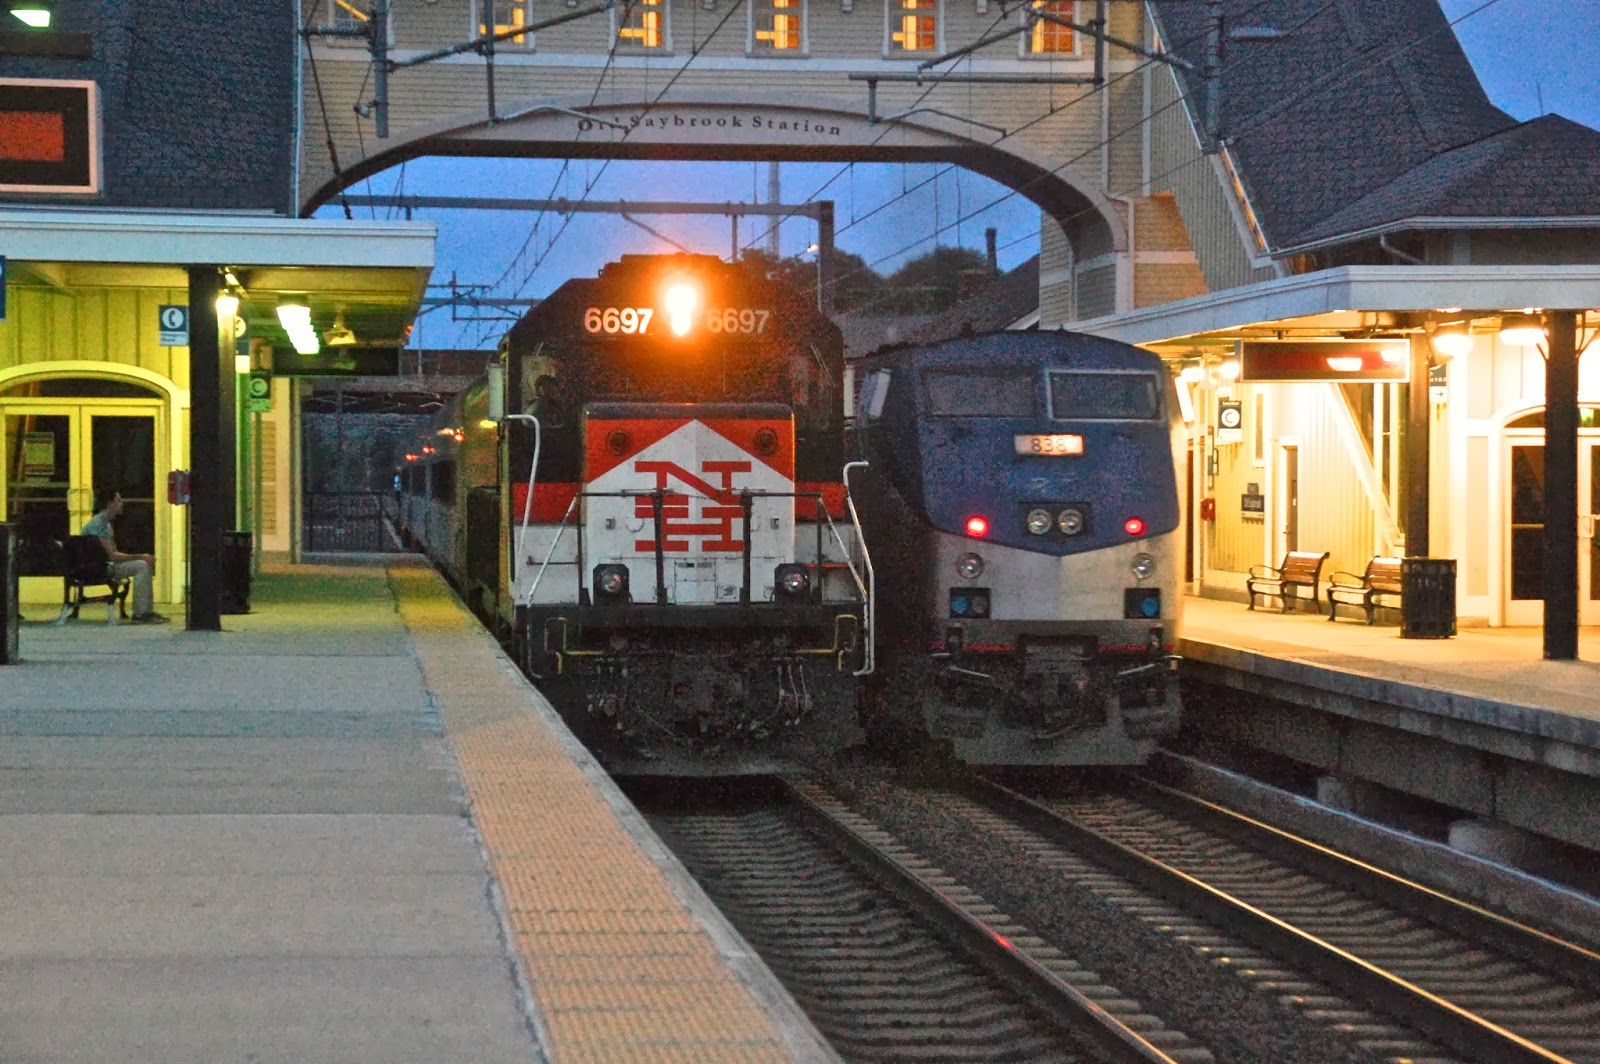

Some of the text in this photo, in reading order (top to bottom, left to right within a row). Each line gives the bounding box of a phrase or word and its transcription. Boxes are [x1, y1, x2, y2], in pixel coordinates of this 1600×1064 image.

[630, 114, 743, 129] Saybrook
[752, 115, 840, 136] Station
[584, 307, 770, 335] 6697 6697
[1031, 438, 1066, 452] 838
